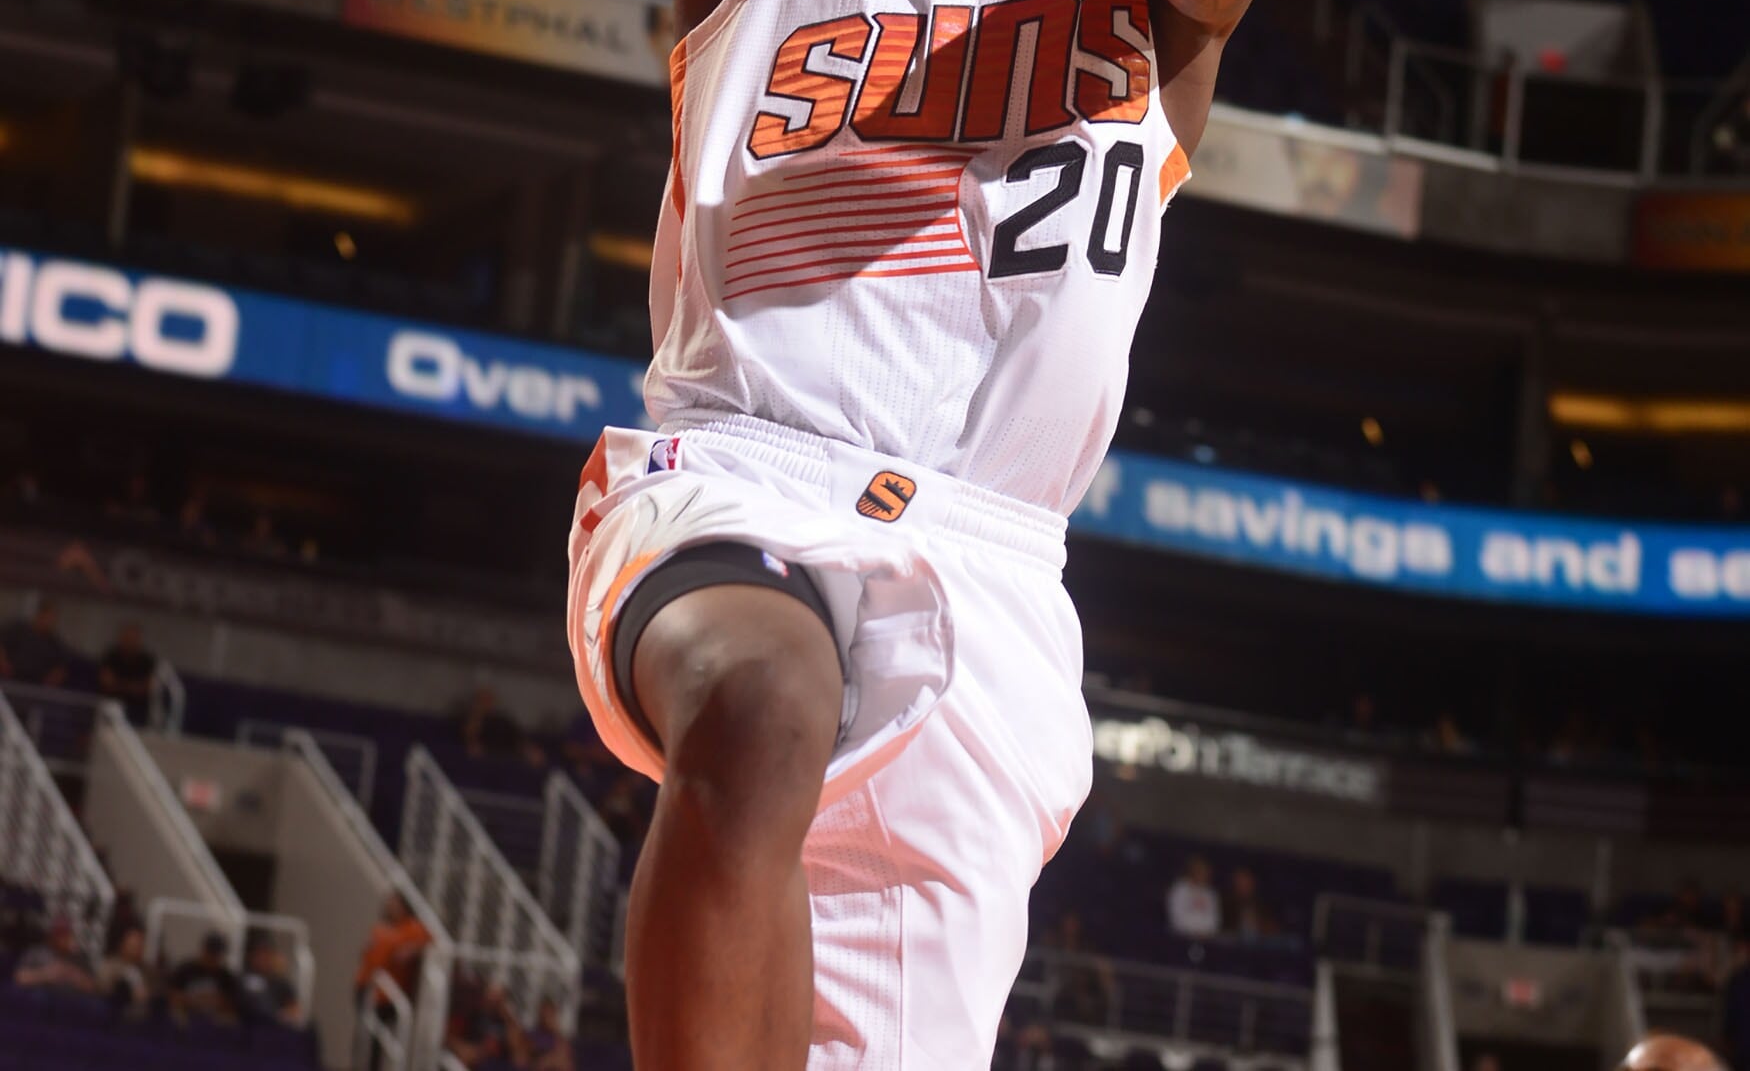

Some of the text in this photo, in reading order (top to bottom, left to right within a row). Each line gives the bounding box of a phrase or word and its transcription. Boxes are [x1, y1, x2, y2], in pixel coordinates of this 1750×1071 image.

[988, 140, 1144, 279] 20
[385, 331, 602, 424] Over
[1145, 480, 1453, 581] savings
[1480, 531, 1641, 594] and
